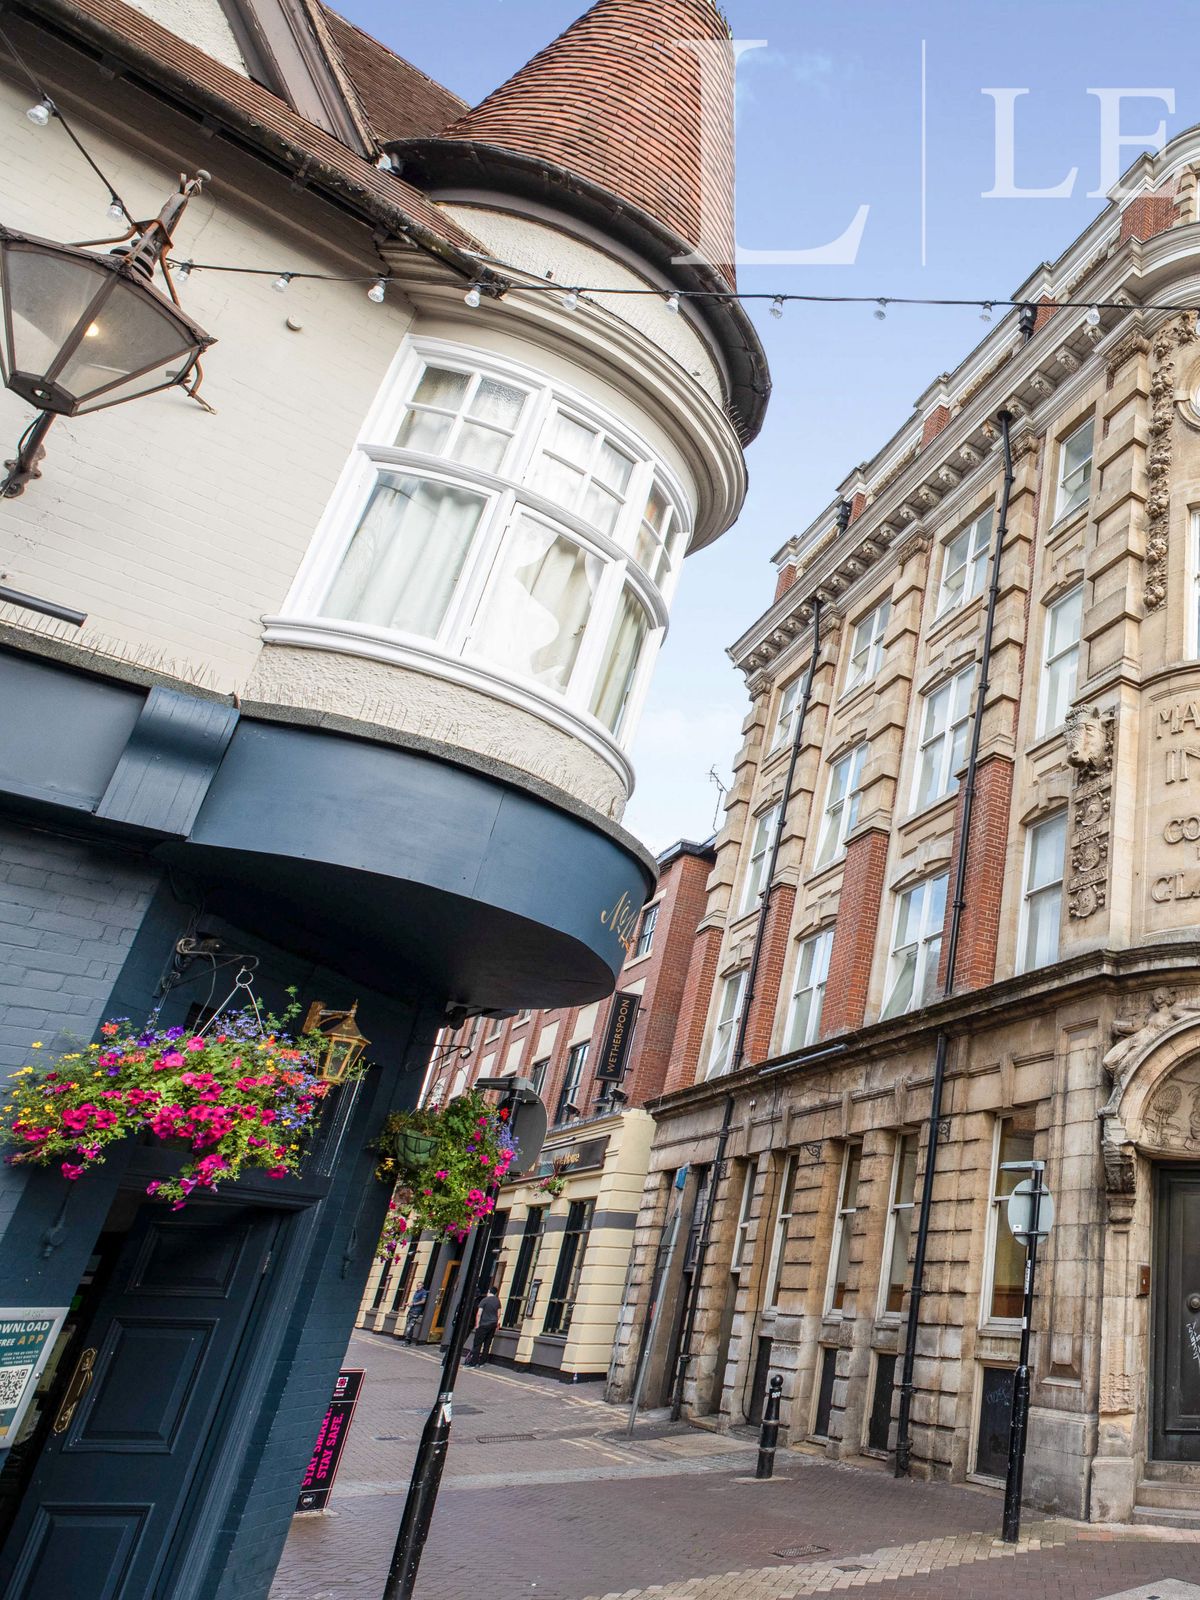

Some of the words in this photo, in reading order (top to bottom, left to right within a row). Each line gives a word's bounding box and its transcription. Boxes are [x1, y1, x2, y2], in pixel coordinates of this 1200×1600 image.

[606, 998, 631, 1073] WETHERSPOON
[17, 1334, 44, 1345] APP
[316, 1449, 334, 1480] STAY
[326, 1412, 345, 1447] SAFE.
